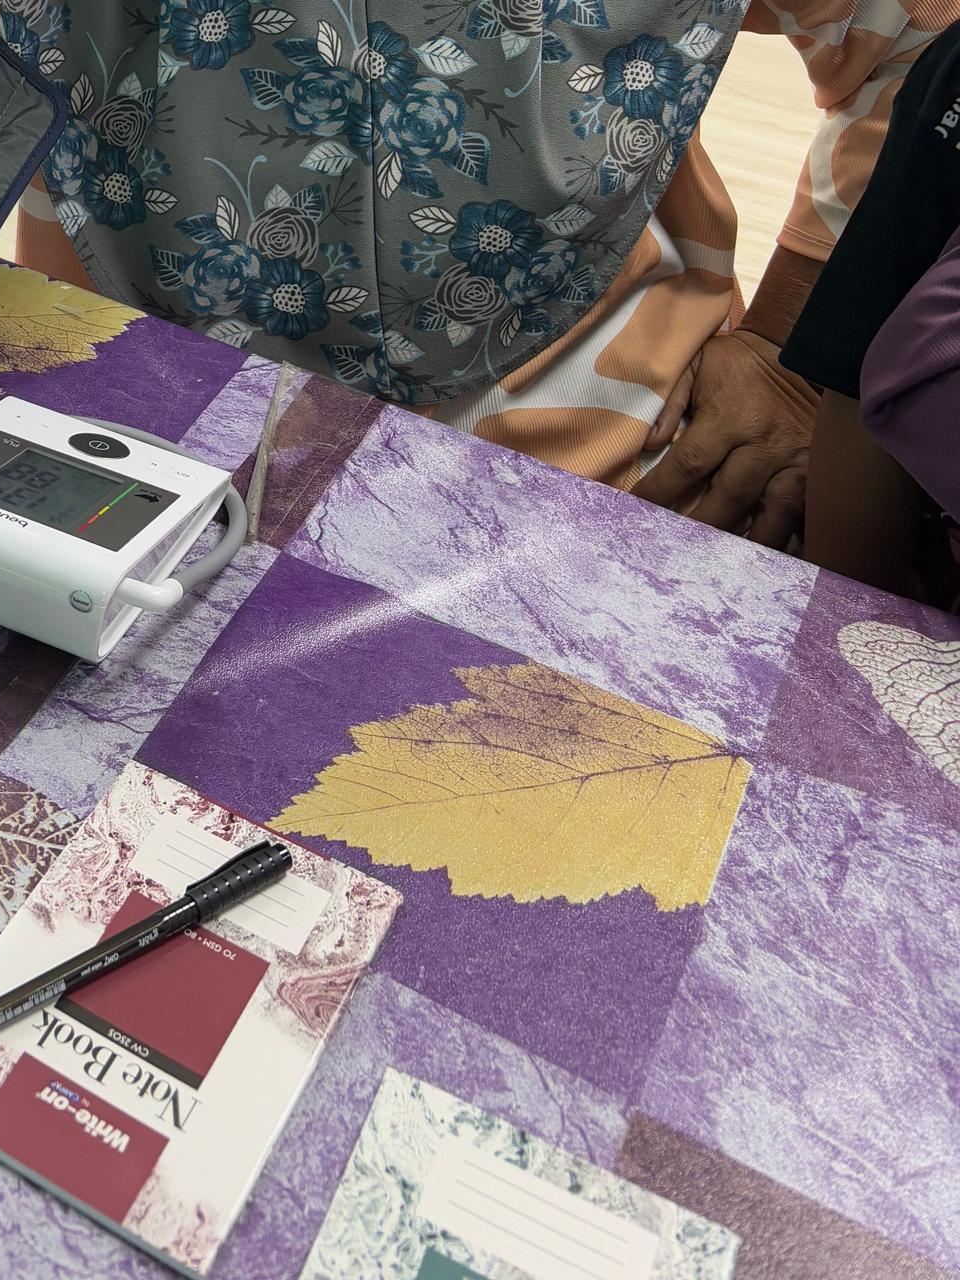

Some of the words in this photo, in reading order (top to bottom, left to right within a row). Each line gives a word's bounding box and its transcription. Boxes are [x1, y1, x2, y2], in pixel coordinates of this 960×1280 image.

[202, 938, 223, 955] GSM
[223, 949, 237, 962] 70
[32, 1007, 122, 1086] Book
[131, 1041, 150, 1058] CW
[37, 1085, 130, 1153] Write-on
[122, 1062, 202, 1134] Note
